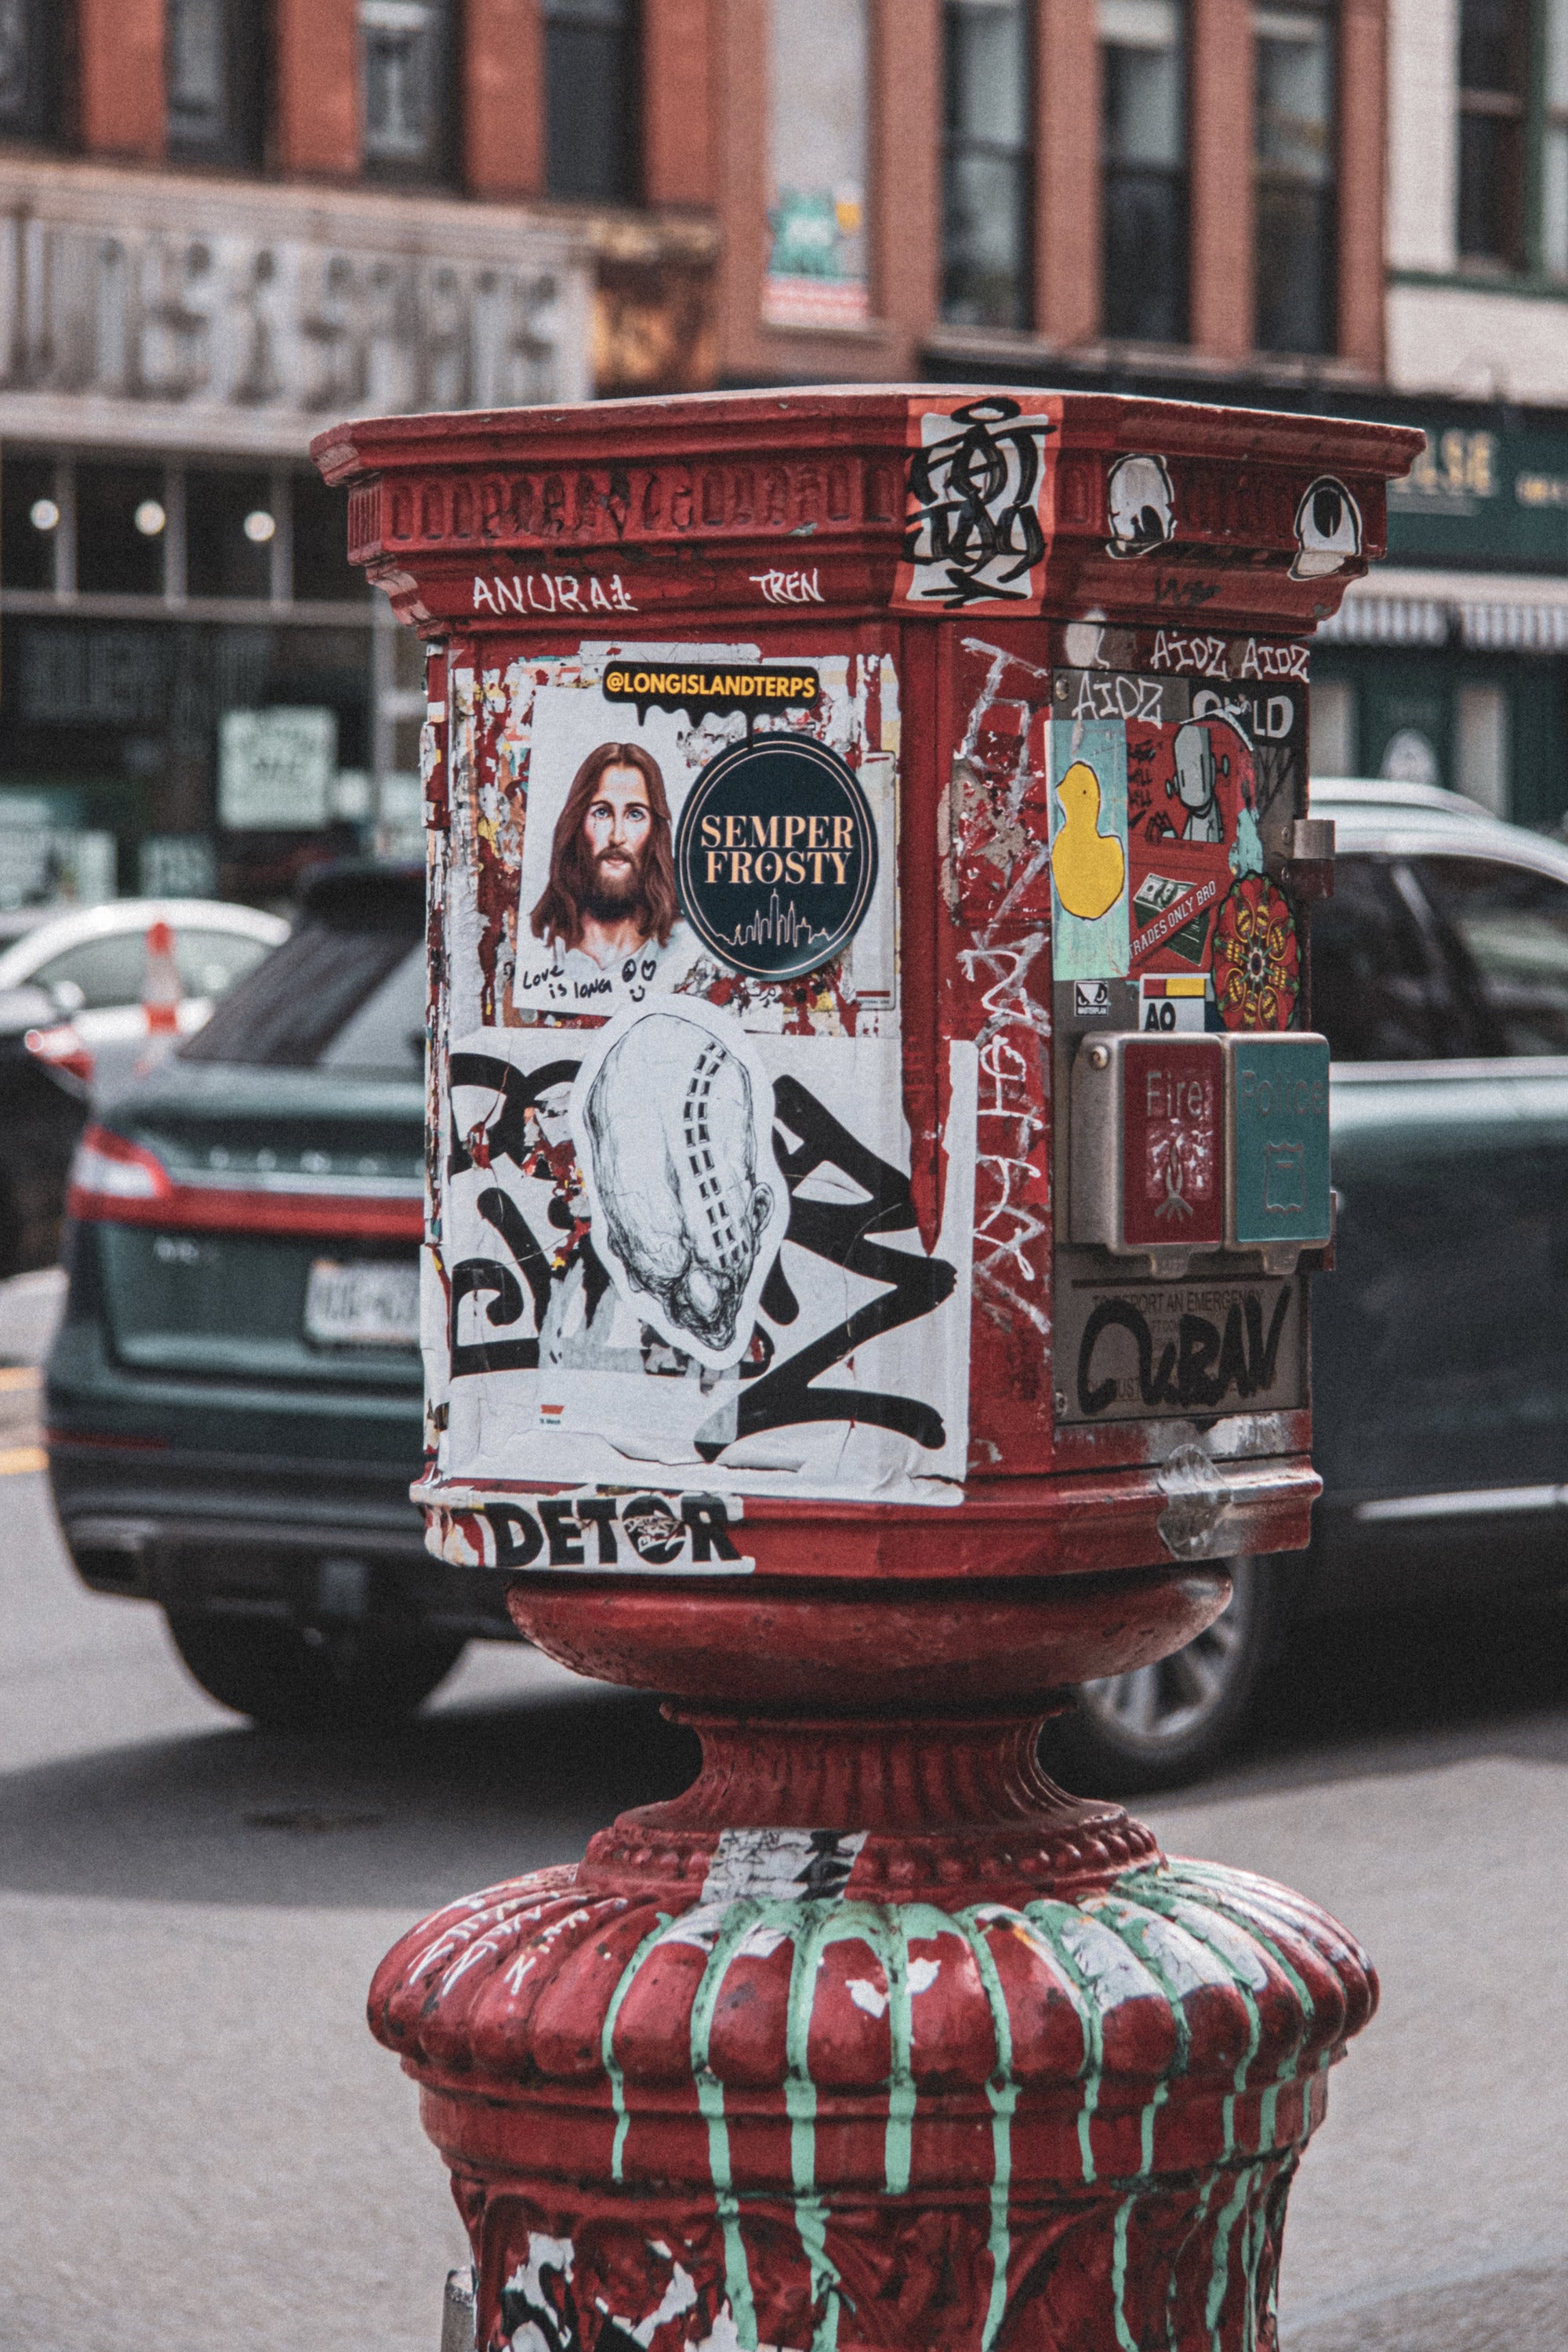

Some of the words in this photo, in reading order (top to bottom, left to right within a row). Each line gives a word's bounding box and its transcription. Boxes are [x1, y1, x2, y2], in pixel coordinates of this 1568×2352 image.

[605, 670, 817, 699] @LONGISLANDTERPS
[700, 815, 855, 849] SEMPER
[704, 851, 854, 885] FROSTY
[1129, 919, 1167, 960] TRADES
[1168, 896, 1194, 928] ONLY
[1196, 880, 1217, 906] BRO
[549, 983, 568, 999] is
[1145, 1071, 1203, 1118] Fire
[1241, 1069, 1326, 1116] Police
